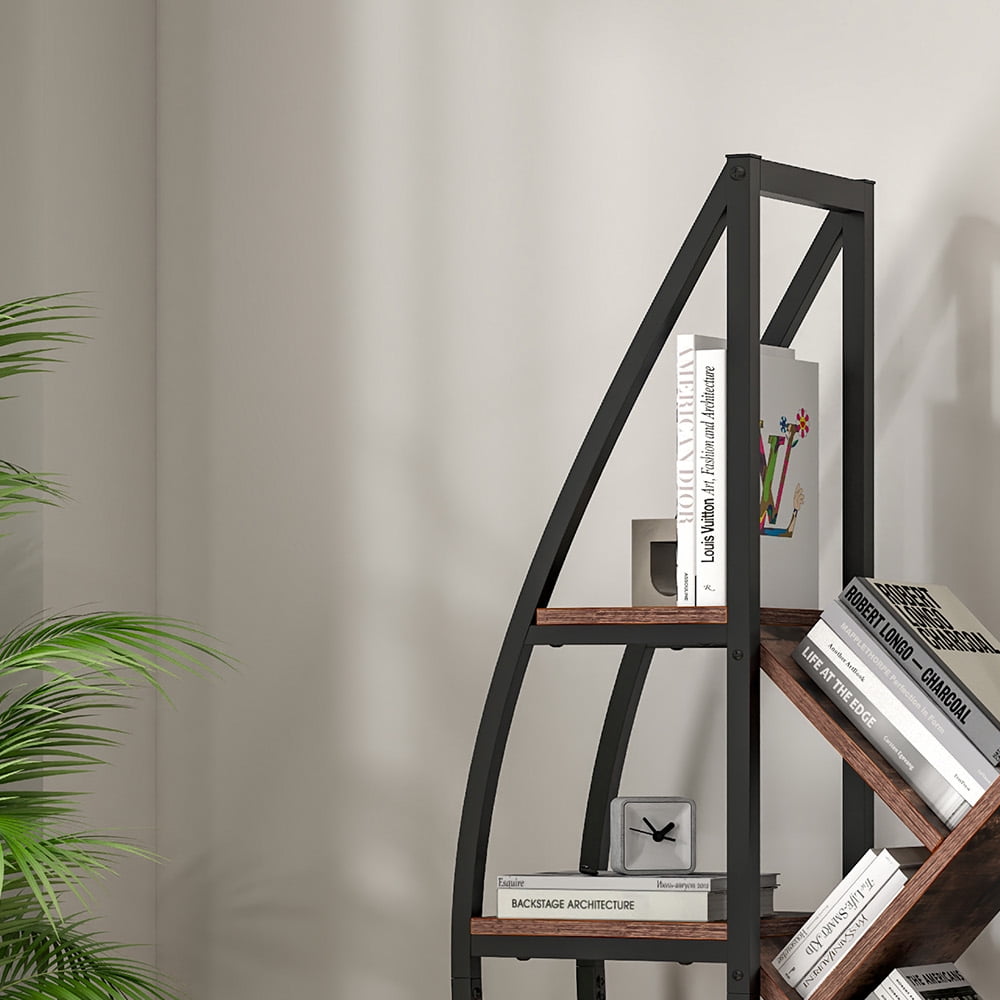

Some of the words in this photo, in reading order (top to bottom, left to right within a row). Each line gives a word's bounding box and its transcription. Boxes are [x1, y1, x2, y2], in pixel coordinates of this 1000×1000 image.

[679, 347, 694, 463] AMERICAN
[700, 366, 716, 420] Architecture
[701, 421, 715, 440] and
[700, 440, 716, 476] Fashion
[679, 469, 694, 524] DIOR
[701, 478, 716, 496] Art,
[700, 498, 715, 534] Vuitton
[701, 535, 715, 563] Louis
[845, 585, 885, 628] ROBERT
[879, 622, 913, 660] LONGO
[921, 668, 971, 724] CHARCOAL
[802, 646, 824, 670] LIFE
[820, 668, 836, 682] AT
[833, 679, 853, 702] THE
[850, 698, 877, 728] EDGE
[498, 877, 525, 888] Esquire
[511, 898, 565, 910] BACKSTAGE
[567, 899, 635, 911] ARCHITECTURE
[922, 970, 965, 984] AMERICANS
